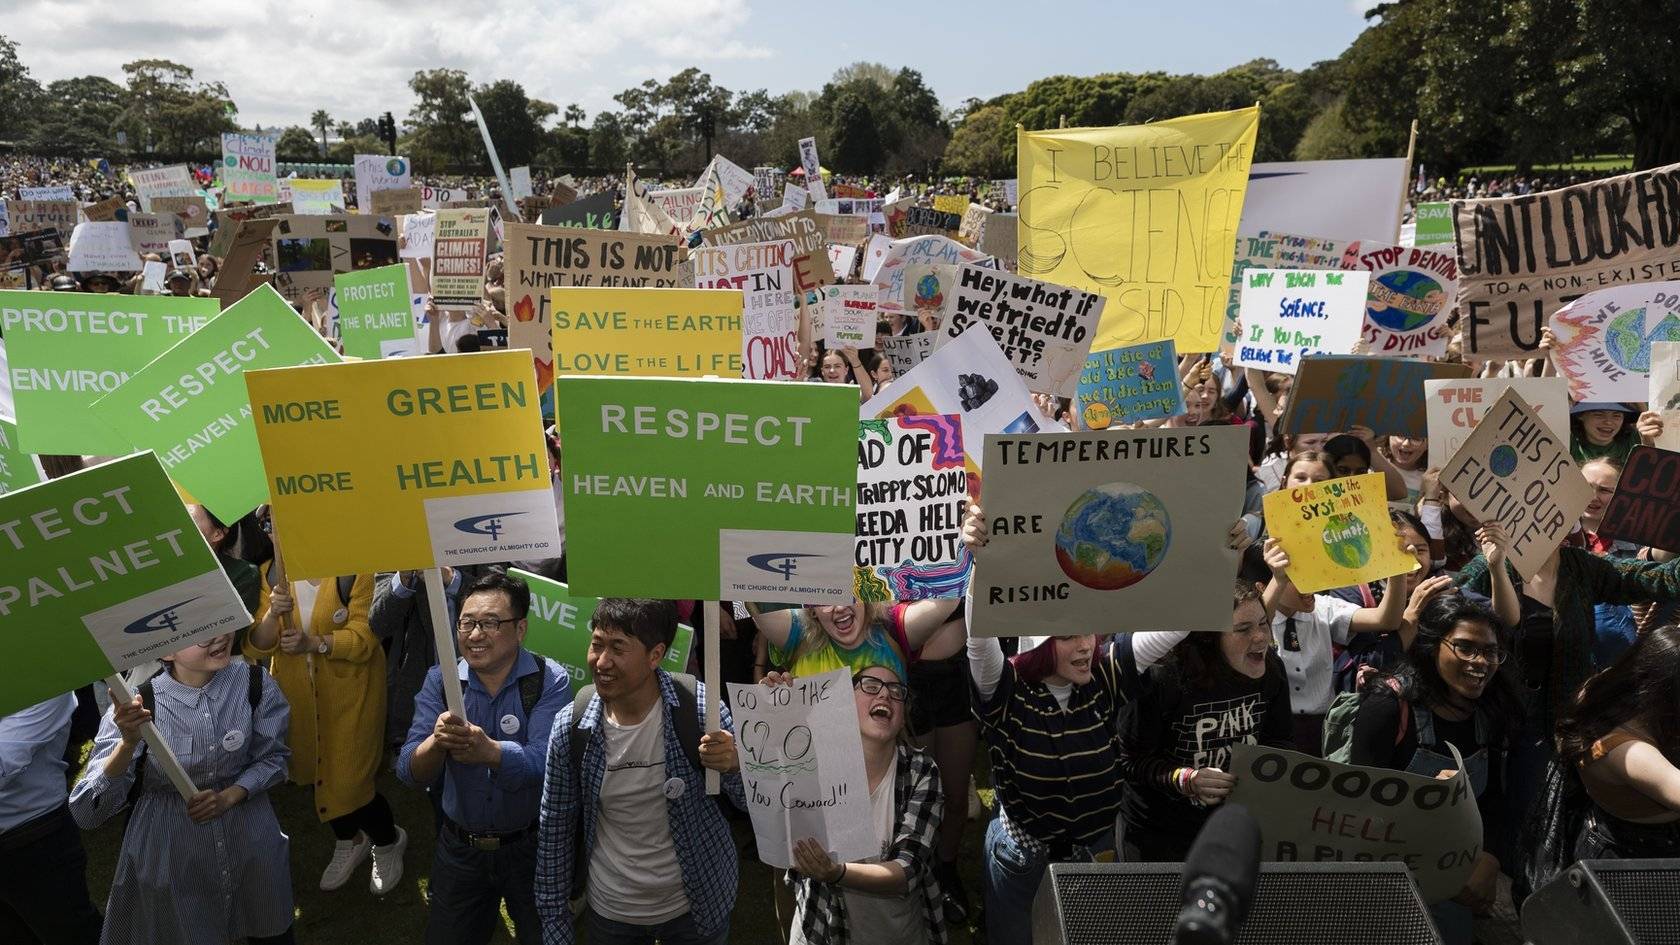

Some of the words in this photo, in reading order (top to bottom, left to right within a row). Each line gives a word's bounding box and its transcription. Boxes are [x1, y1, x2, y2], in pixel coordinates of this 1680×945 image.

[239, 156, 271, 172] NOW
[359, 159, 382, 173] This
[1047, 149, 1063, 183] I
[1094, 144, 1209, 181] BELIEVE
[1215, 142, 1248, 172] THE
[434, 189, 450, 202] TO
[439, 229, 479, 237] AUSTRALIA'S
[440, 220, 456, 229] STOP
[799, 217, 816, 234] TO
[1018, 185, 1243, 287] SCIENCE
[437, 241, 481, 257] CLIMATE
[527, 236, 590, 270] THIS
[601, 242, 625, 269] IS
[635, 245, 679, 273] NOT
[735, 241, 795, 271] GETTING
[912, 239, 959, 264] DREAM
[1247, 238, 1278, 258] THE
[1361, 246, 1405, 272] STOP
[436, 258, 481, 274] CRIMES!
[343, 282, 395, 302] PROTECT
[520, 270, 565, 288] WHAT
[573, 274, 592, 288] WE
[601, 277, 649, 289] MEANT
[751, 270, 781, 291] IN
[960, 268, 1008, 302] Hey,
[1011, 283, 1072, 311] what
[1075, 293, 1098, 316] if
[1250, 272, 1274, 288] WHY
[1286, 273, 1316, 288] TEACH
[1484, 281, 1509, 295] TO
[1518, 283, 1530, 293] A
[752, 291, 794, 309] HERE
[1400, 296, 1441, 314] EARTH
[1588, 301, 1621, 325] WE
[2, 308, 148, 336] PROTECT
[162, 315, 208, 335] THE
[343, 317, 360, 330] THE
[364, 312, 408, 329] PLANET
[555, 311, 628, 331] SAVE
[632, 318, 664, 330] THE
[666, 314, 742, 332] EARTH
[948, 313, 1003, 341] Se
[1008, 326, 1045, 352] the
[957, 296, 993, 320] we
[996, 300, 1064, 337] tried
[1062, 315, 1086, 343] to
[883, 338, 913, 350] WTF
[918, 338, 930, 347] is
[1383, 326, 1441, 351] DYING
[557, 353, 630, 372] LOVE
[636, 358, 668, 368] THE
[676, 353, 742, 372] LIFE
[888, 354, 912, 365] The
[1589, 347, 1626, 382] HAVE
[140, 327, 271, 423] RESPECT
[262, 399, 342, 424] MORE
[387, 381, 527, 417] GREEN
[1438, 387, 1483, 404] THE
[600, 403, 812, 447] RESPECT
[160, 413, 238, 470] HEAVEN
[898, 433, 931, 466] OF
[997, 434, 1211, 465] TEMPERATURES
[1499, 400, 1553, 463] THIS
[1542, 451, 1569, 485] IS
[275, 472, 354, 496] MORE
[396, 453, 540, 491] HEALTH
[912, 470, 966, 500] SCOMO
[573, 473, 688, 499] HEAVEN
[704, 483, 745, 500] AND
[755, 481, 851, 507] EARTH
[920, 503, 966, 532] HELP
[1451, 456, 1540, 556] FUTURE
[1524, 480, 1565, 540] OUR
[992, 515, 1043, 536] ARE
[1323, 522, 1369, 544] Climate
[459, 547, 488, 555] CHURCH
[499, 543, 533, 551] ALMIGHTY
[855, 537, 905, 567] CITY
[911, 532, 958, 562] OUT
[0, 528, 185, 616] PALNET
[747, 584, 777, 592] CHURCH
[789, 585, 826, 594] ALMIGHTY
[989, 583, 1069, 605] RISING
[121, 651, 136, 660] THE
[138, 640, 169, 655] CHURCH
[181, 622, 218, 639] ALMIGHTY
[219, 615, 235, 625] GOD
[737, 688, 757, 710] GO
[771, 683, 791, 707] TO
[800, 679, 834, 707] THE
[1195, 700, 1256, 753] PINK
[749, 780, 771, 808] You
[780, 781, 848, 809] Coward!!
[1311, 806, 1406, 844] HELL
[1437, 844, 1479, 870] ON
